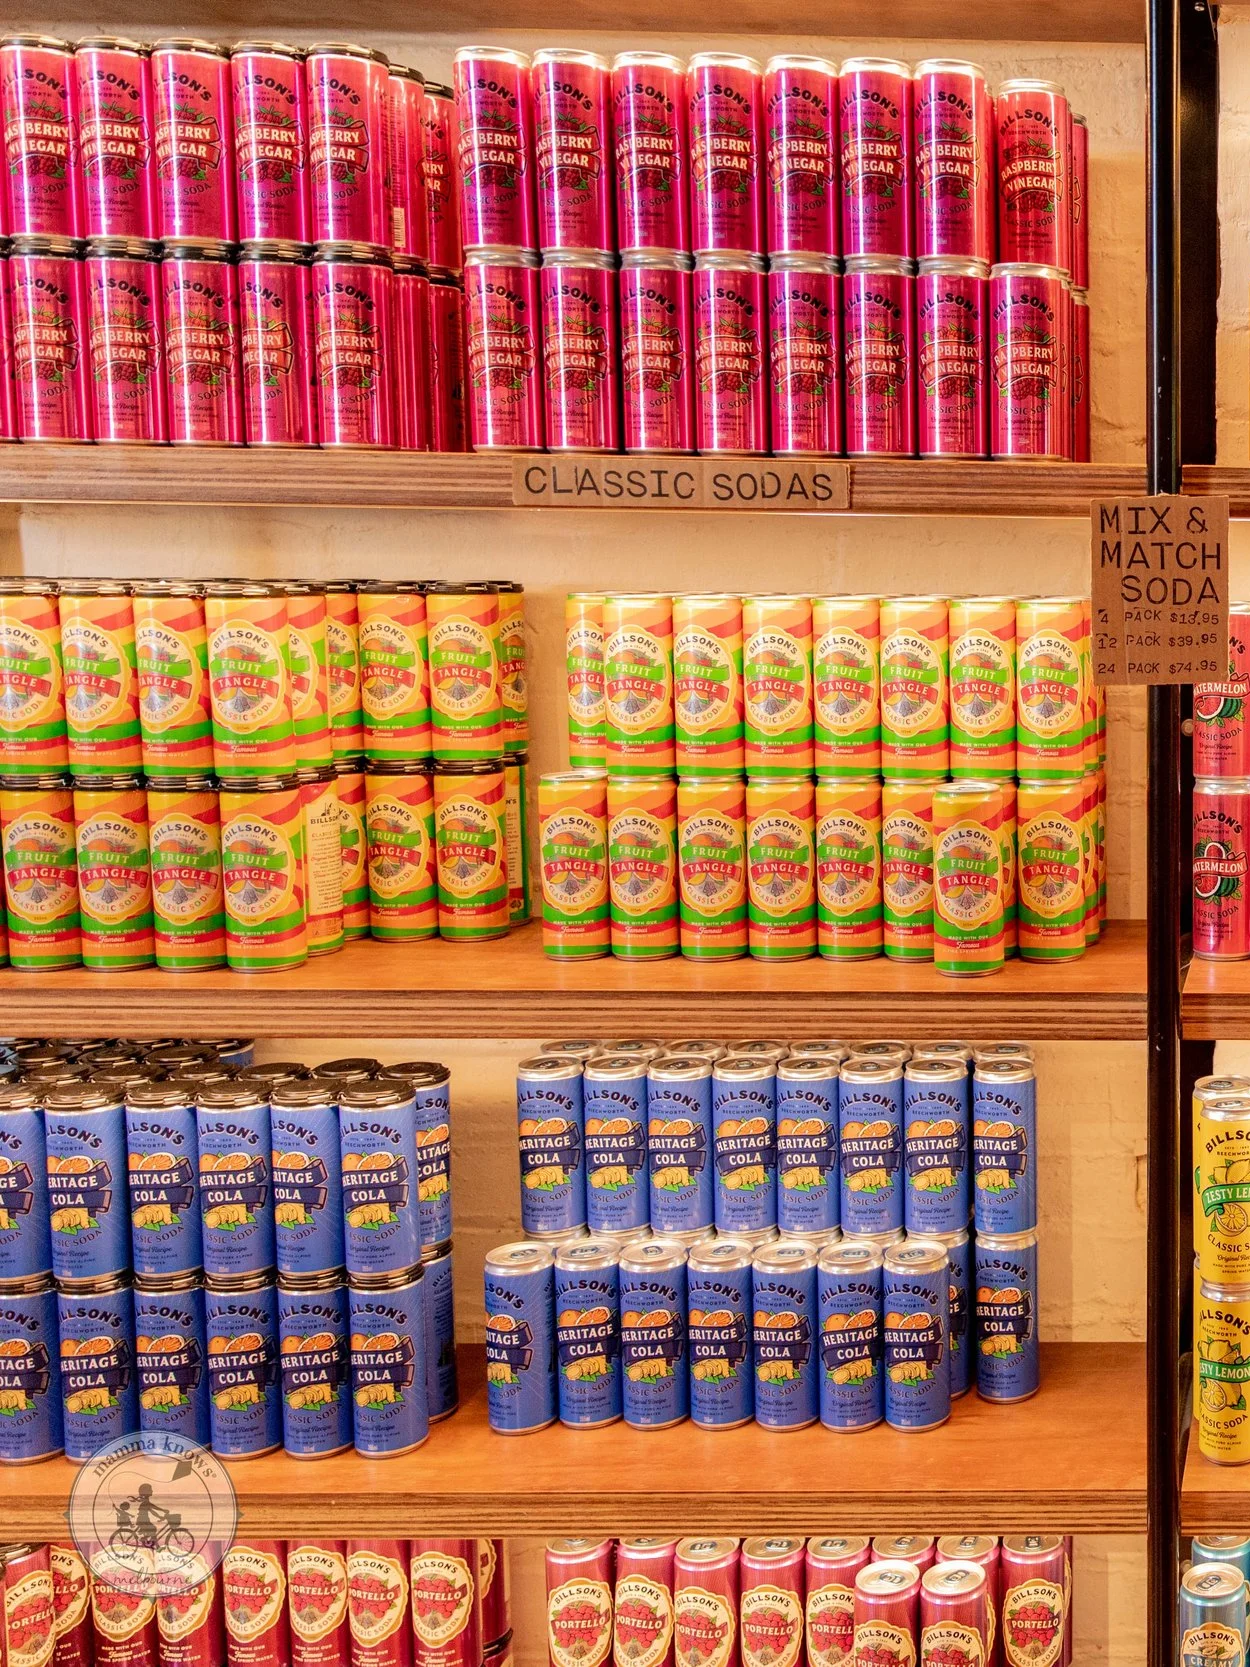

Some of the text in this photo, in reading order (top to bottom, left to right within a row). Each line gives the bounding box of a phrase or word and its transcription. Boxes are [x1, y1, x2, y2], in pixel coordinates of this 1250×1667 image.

[768, 143, 827, 161] RASPBERRY
[1001, 160, 1055, 180] RASPBERRY
[1008, 177, 1055, 191] VINEGAR
[524, 466, 833, 500] CLASSIC SODAS
[1101, 504, 1208, 534] MIX &
[1101, 541, 1221, 569] MATCH
[1121, 575, 1220, 605] SODA
[1100, 611, 1218, 625] 4 PACK $13.95
[213, 629, 269, 649] BILLSON'S
[434, 624, 484, 642] BILLSON'S
[608, 634, 658, 654] BILLSON'S
[1024, 639, 1072, 658] BILLSON'S
[1098, 634, 1217, 649] 12 PACK $39.95
[442, 653, 477, 664] FRUIT
[222, 660, 262, 673] FRUIT
[438, 667, 482, 679] TANGLE
[615, 663, 651, 676] FRUIT
[1098, 660, 1217, 673] 24 PACK $74.95
[1032, 668, 1066, 680] FRUIT
[218, 678, 269, 689] TANGLE
[611, 680, 656, 692] TANGLE
[1028, 684, 1070, 696] TANGLE
[610, 704, 660, 723] CLASSIC SODA
[9, 822, 68, 841] BILLSON'S
[547, 817, 597, 835] BILLSON'S
[943, 829, 992, 848] BILLSON'S
[17, 851, 58, 864] FRUIT
[554, 846, 590, 857] FRUIT
[551, 861, 595, 872] TANGLE
[951, 859, 986, 871] FRUIT
[14, 868, 65, 880] TANGLE
[946, 874, 990, 886] TANGLE
[549, 884, 598, 904] CLASSIC SODA
[944, 898, 993, 918] CLASSIC SODA
[561, 926, 585, 934] Famous
[956, 941, 980, 949] Famous
[717, 1134, 771, 1152] HERITAGE
[906, 1137, 959, 1152] HERITAGE
[729, 1152, 761, 1165] COLA
[918, 1154, 949, 1166] COLA
[351, 1189, 387, 1203] COLA
[1206, 1189, 1233, 1203] ZESTY
[1207, 1234, 1243, 1253] CLASSIC
[1217, 1254, 1239, 1263] Original
[558, 1324, 613, 1342] HERITAGE
[984, 1320, 1014, 1332] COLA
[823, 1327, 878, 1346] HERITAGE
[570, 1342, 603, 1356] COLA
[837, 1346, 870, 1360] COLA
[208, 1350, 267, 1370] HERITAGE
[218, 1370, 255, 1384] COLA
[414, 1588, 461, 1600] PORTELLO
[555, 1587, 602, 1605] BILLSON'S
[1012, 1587, 1057, 1604] BILLSON'S
[555, 1617, 605, 1629] PORTELLO
[1011, 1617, 1059, 1629] PORTELLO
